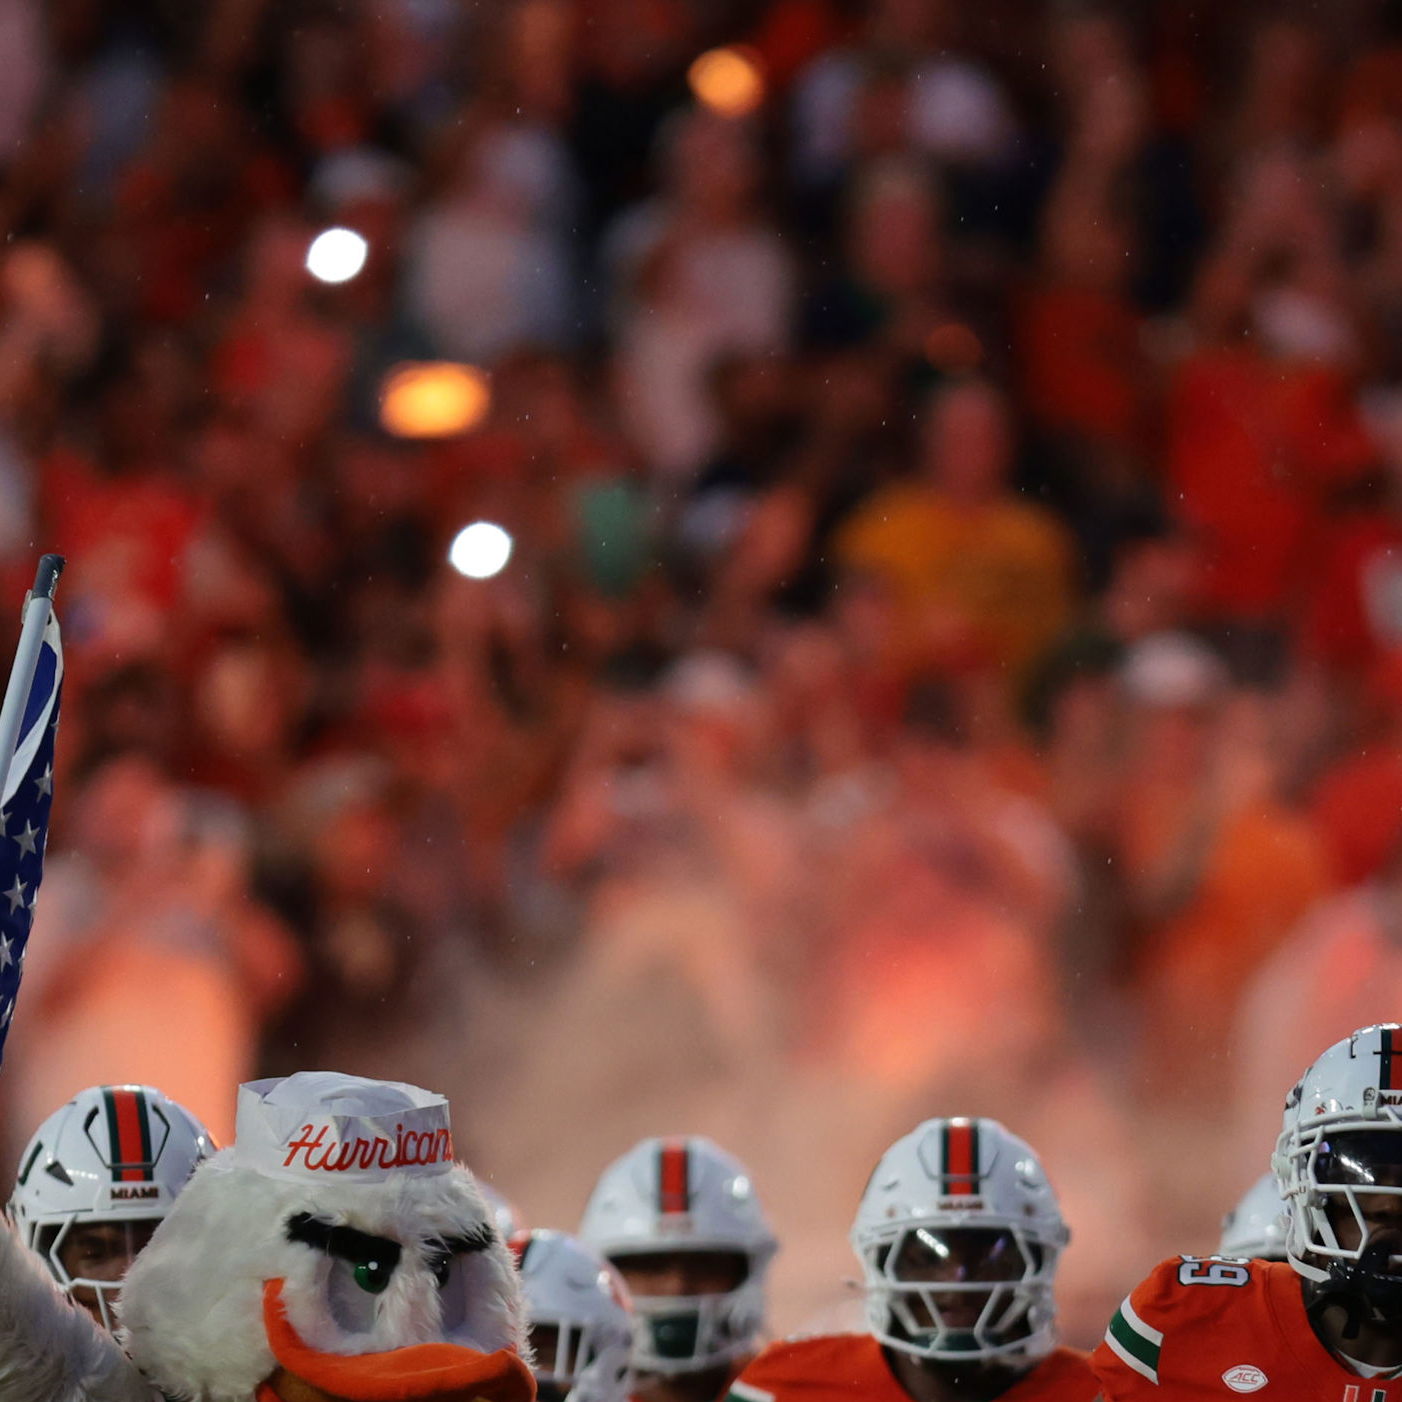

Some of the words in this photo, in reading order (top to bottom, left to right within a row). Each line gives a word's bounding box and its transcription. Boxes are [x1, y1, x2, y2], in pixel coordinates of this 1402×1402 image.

[283, 1124, 453, 1172] Hurrican
[110, 1187, 159, 1200] MIAMI
[1229, 1372, 1261, 1384] ACC
